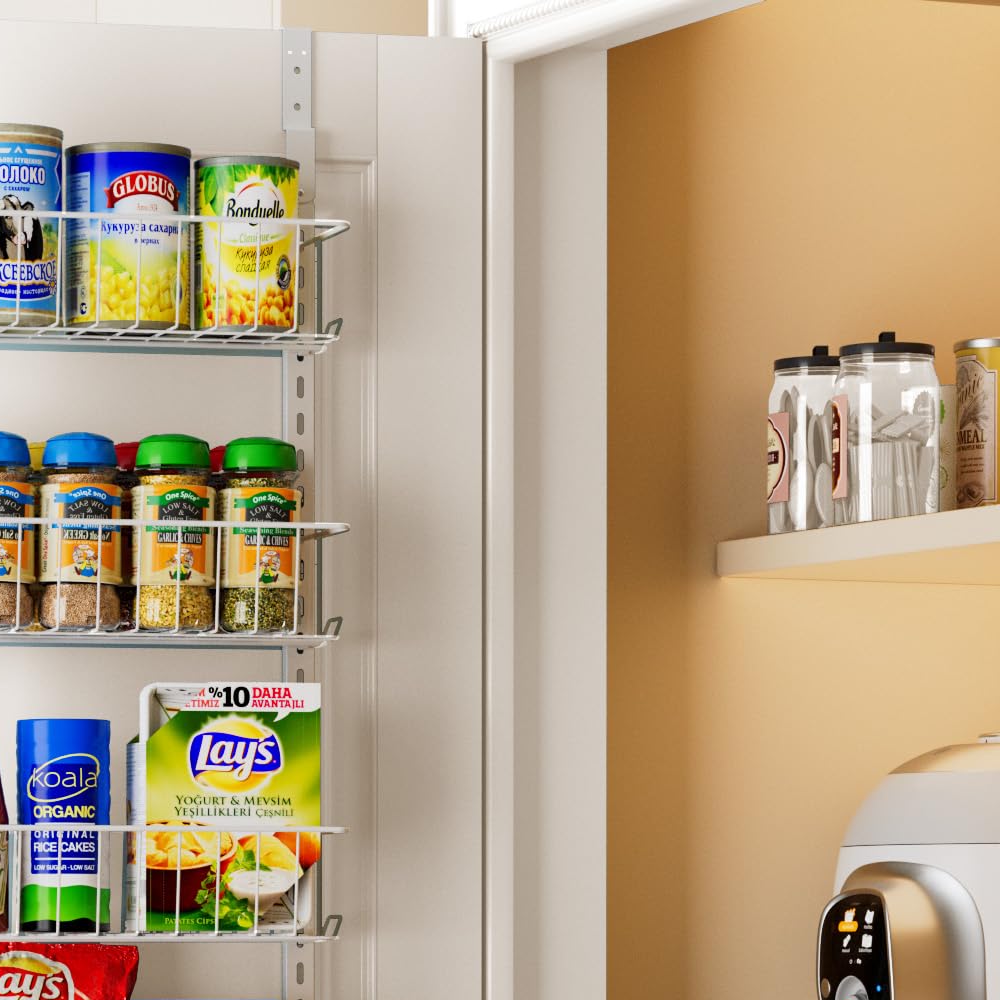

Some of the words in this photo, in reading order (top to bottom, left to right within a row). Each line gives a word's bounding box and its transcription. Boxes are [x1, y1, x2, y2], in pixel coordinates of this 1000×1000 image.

[112, 171, 175, 202] GLOBUS
[235, 245, 274, 263] Кукууза
[251, 687, 293, 699] DAHA
[31, 767, 98, 788] koala
[175, 794, 228, 806] YOĞURT
[230, 796, 241, 806] &
[243, 795, 292, 806] MEVSİM
[33, 805, 96, 819] ORGANIC
[33, 841, 58, 853] RICE
[61, 841, 96, 853] CAKES
